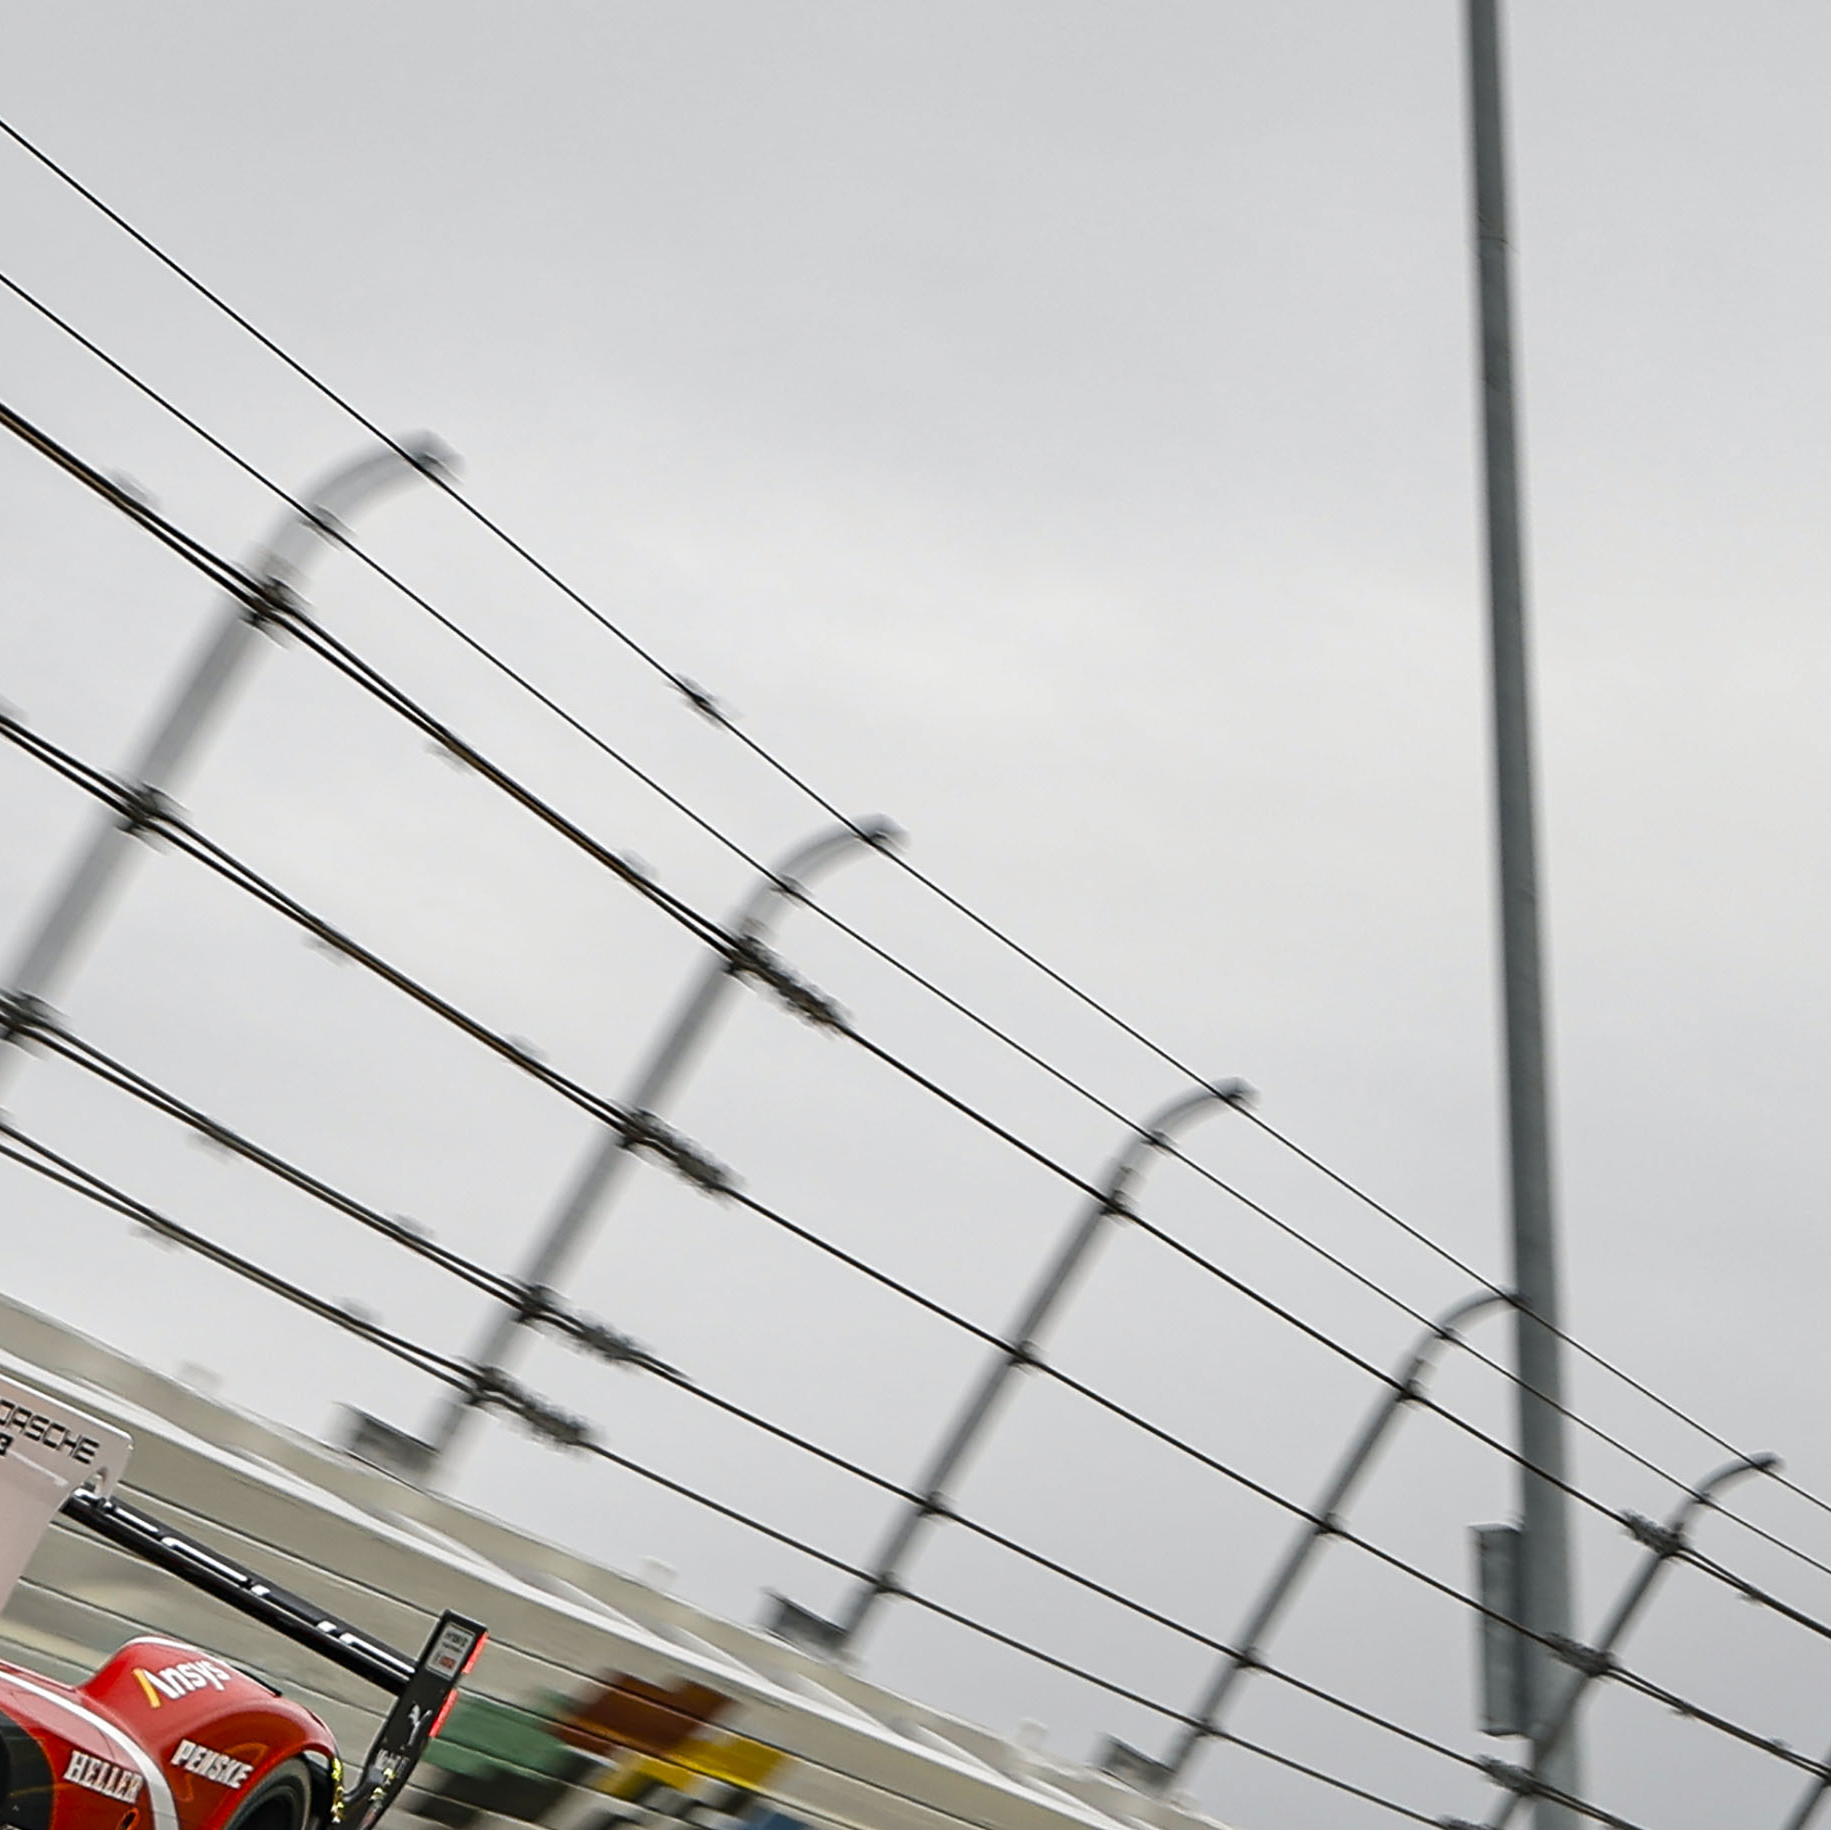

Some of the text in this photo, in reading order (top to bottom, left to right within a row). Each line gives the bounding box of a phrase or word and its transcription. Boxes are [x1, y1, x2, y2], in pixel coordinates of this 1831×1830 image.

[131, 1659, 231, 1709] Ansys
[62, 1749, 145, 1805] HELLER
[169, 1738, 254, 1790] PENSKE
